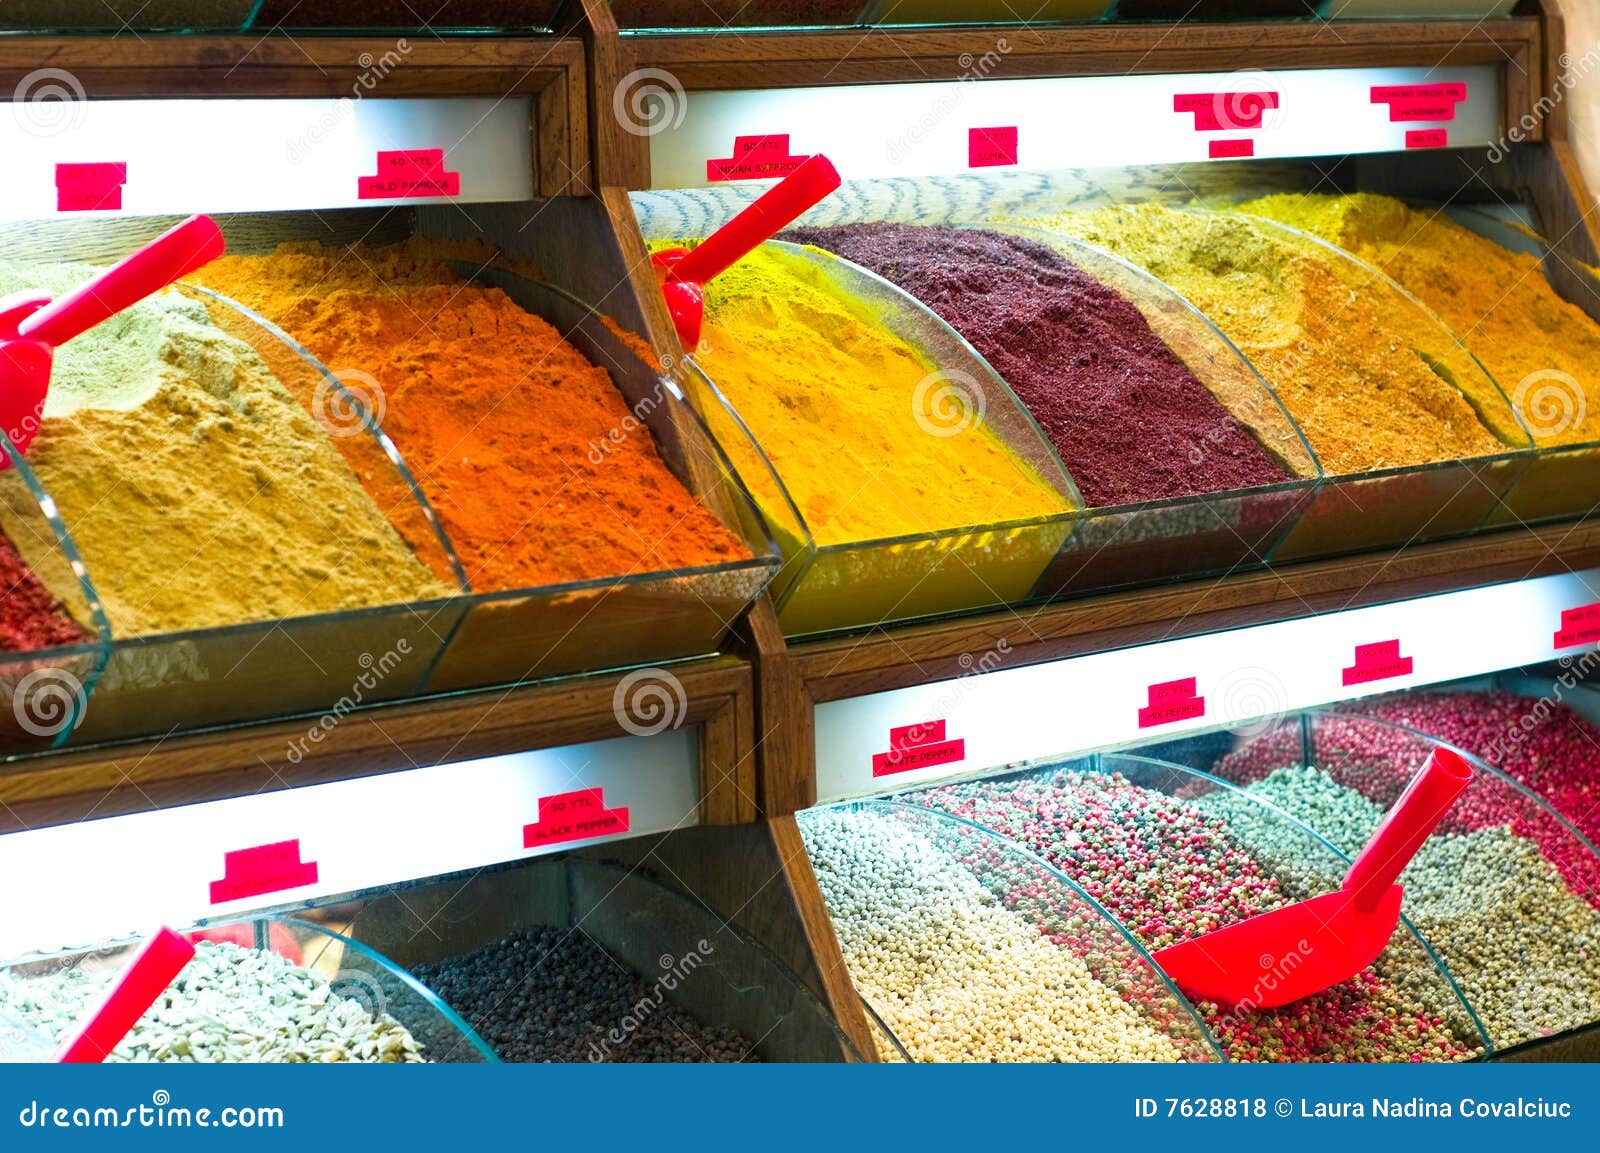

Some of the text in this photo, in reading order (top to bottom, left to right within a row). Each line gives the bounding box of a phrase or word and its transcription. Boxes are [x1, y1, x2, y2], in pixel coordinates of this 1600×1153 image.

[718, 162, 752, 174] INDIAN
[919, 746, 956, 762] PEPPER
[575, 816, 619, 832] PEPPER
